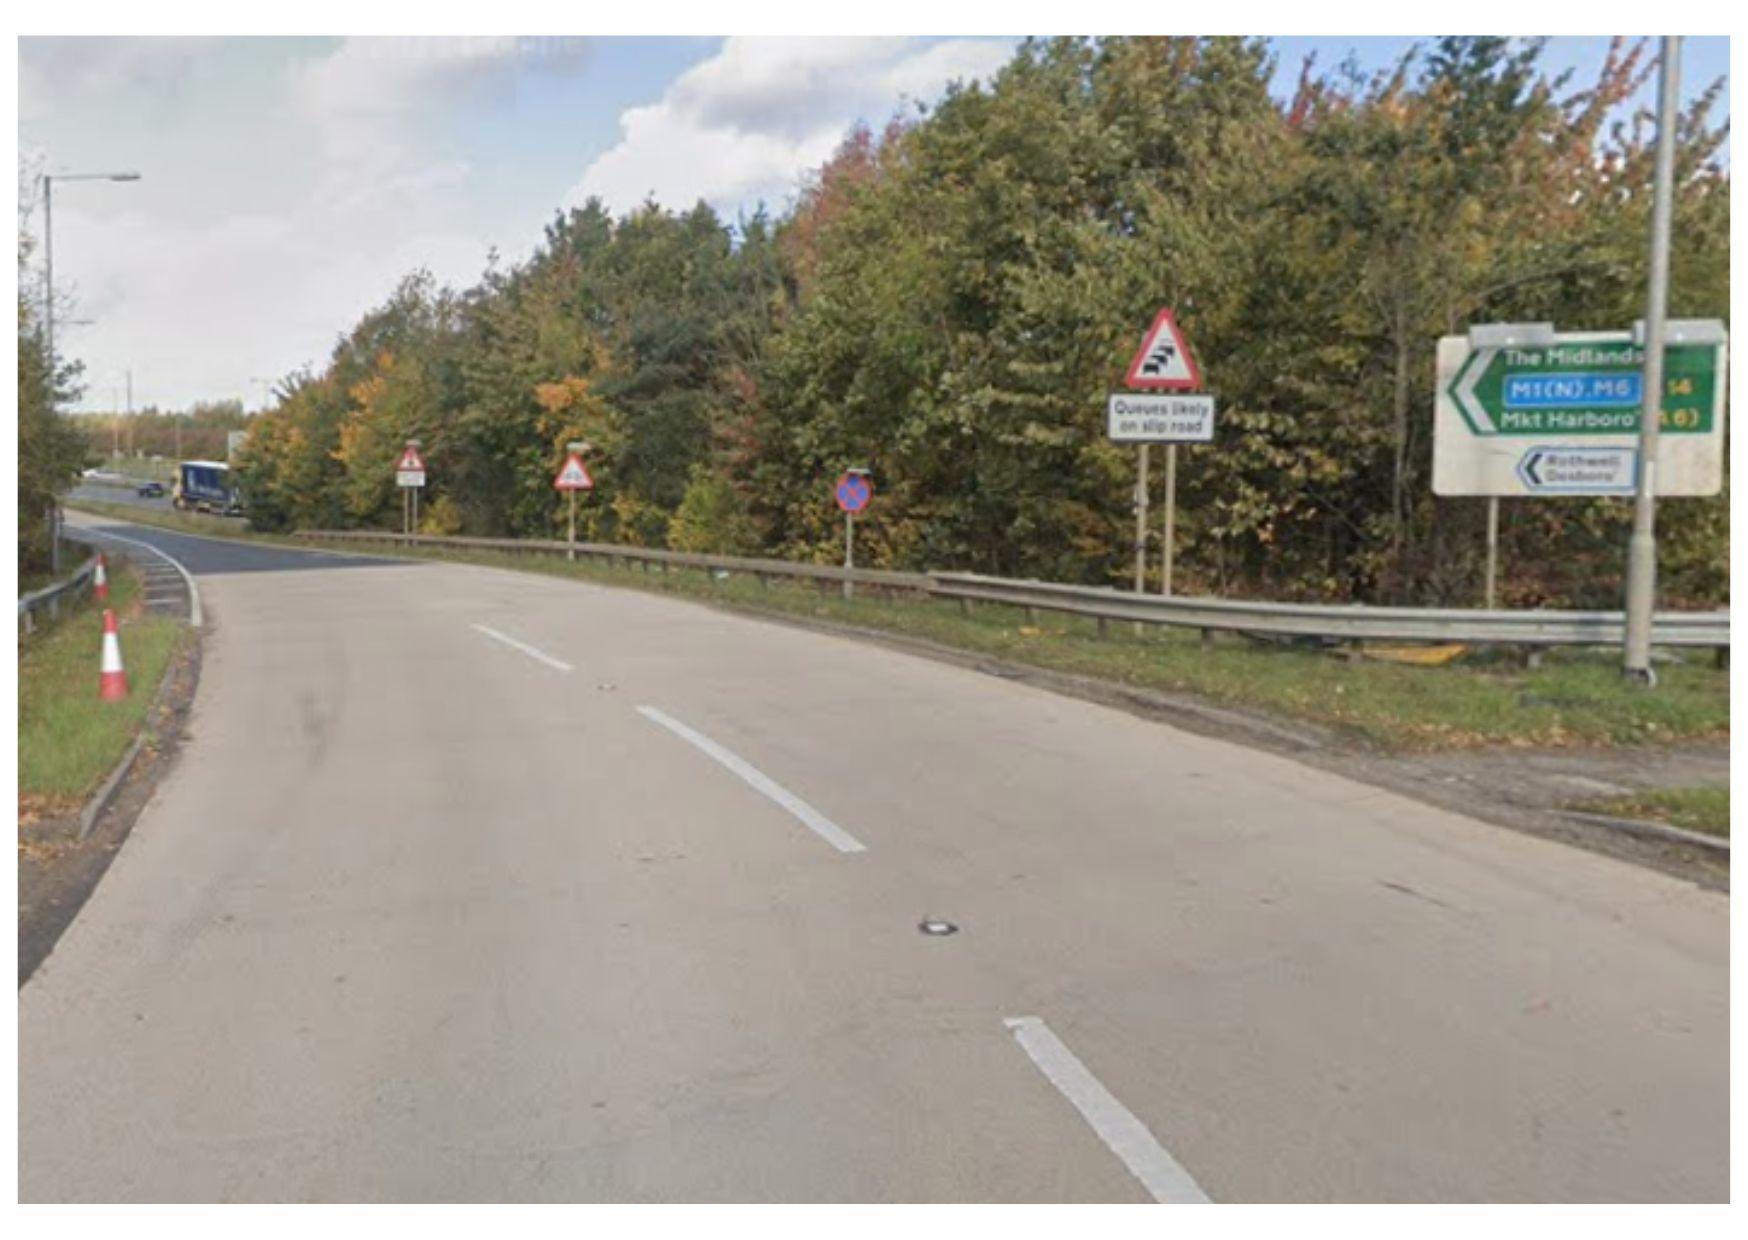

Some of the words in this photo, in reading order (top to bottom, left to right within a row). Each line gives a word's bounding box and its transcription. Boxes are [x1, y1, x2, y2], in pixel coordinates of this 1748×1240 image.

[1506, 350, 1541, 366] The
[1548, 348, 1646, 366] Midlands
[1115, 399, 1167, 415] Queues
[1172, 401, 1209, 419] likely
[1120, 421, 1137, 433] on
[1143, 419, 1166, 434] slip
[1171, 420, 1202, 433] road
[1501, 413, 1541, 428] Mkt
